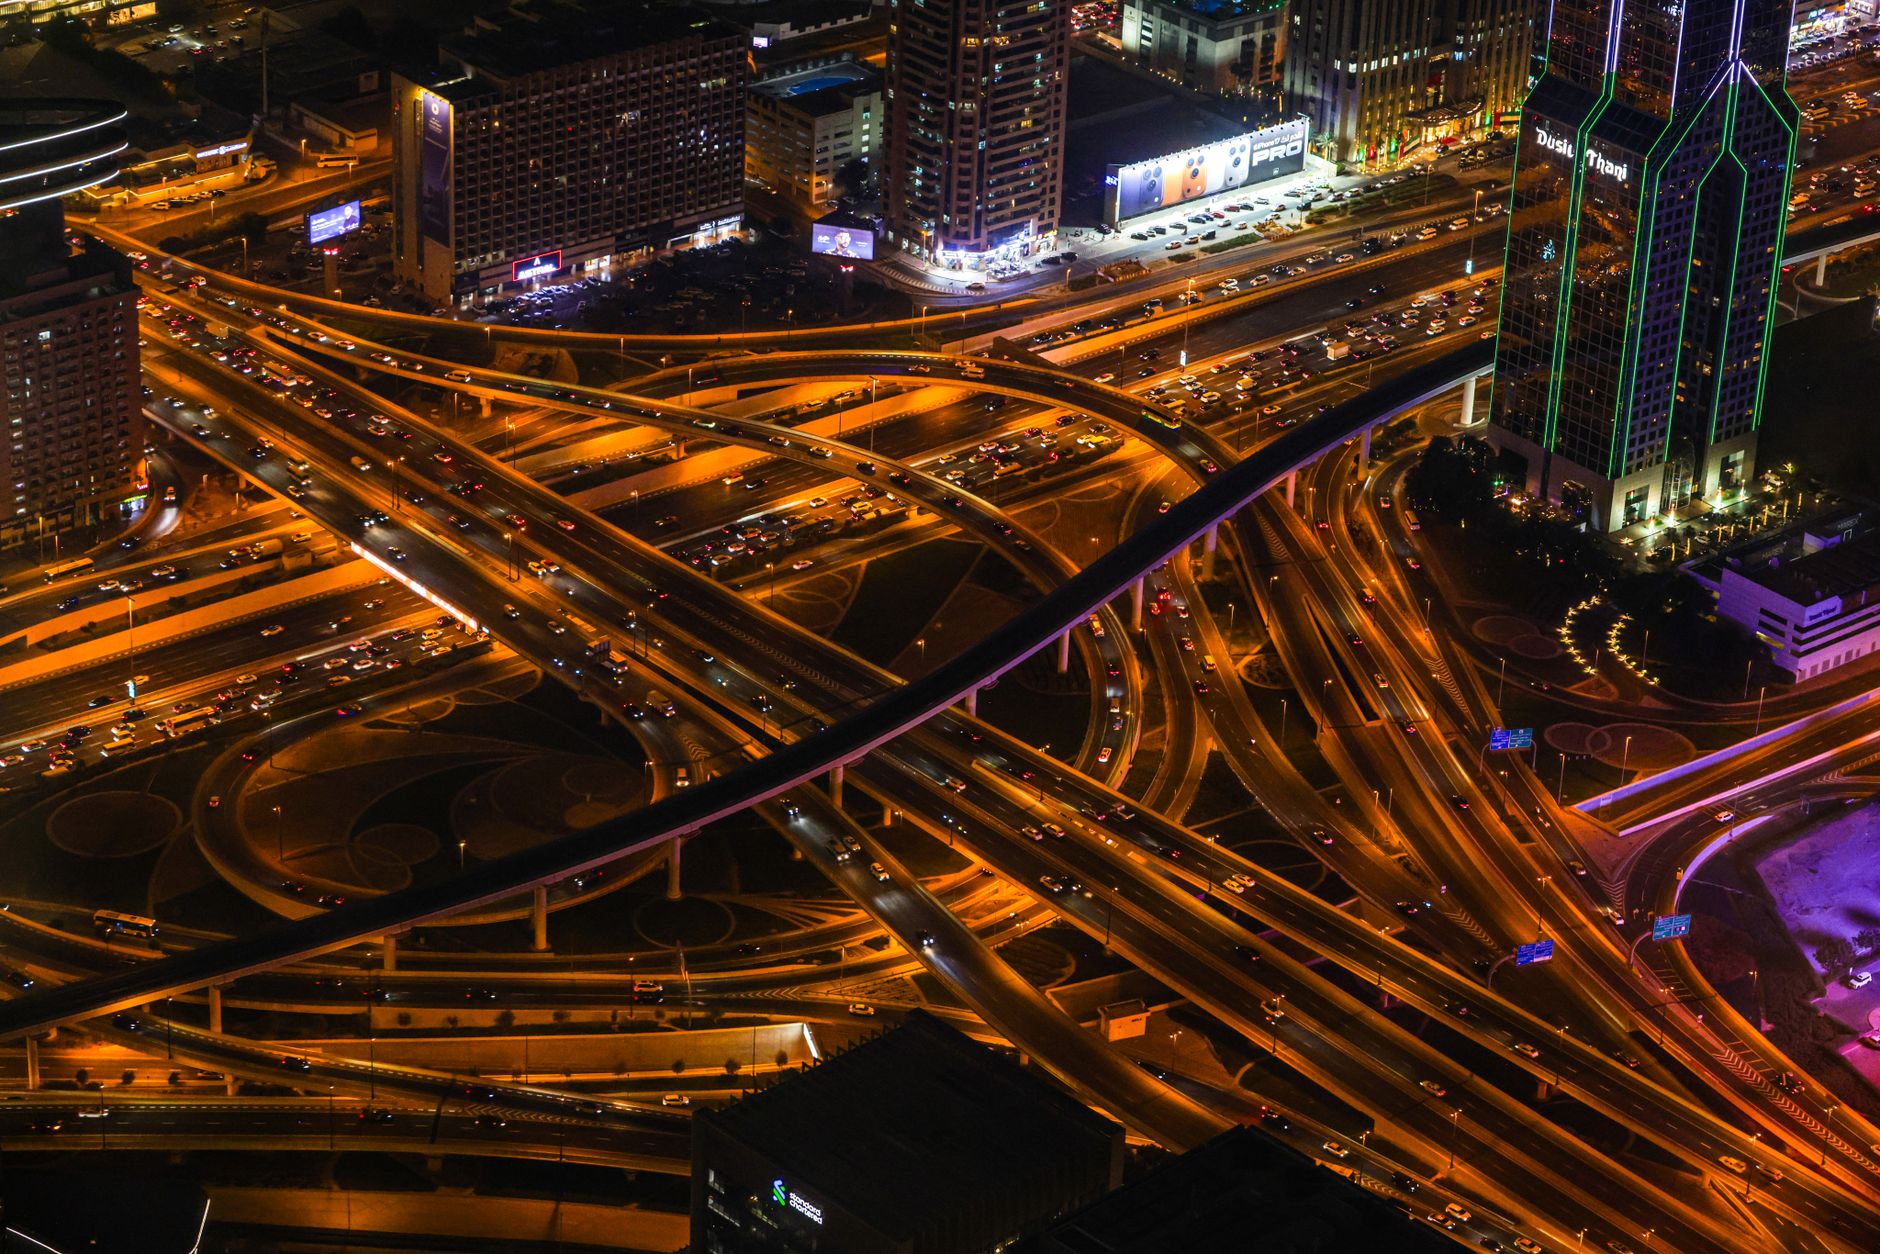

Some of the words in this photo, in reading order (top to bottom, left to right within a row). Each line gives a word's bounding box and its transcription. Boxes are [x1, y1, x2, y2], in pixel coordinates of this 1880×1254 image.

[1252, 140, 1303, 167] PRO
[1257, 141, 1275, 149] iPhone
[1535, 126, 1575, 158] Dusit
[1585, 147, 1628, 182] Thani
[517, 263, 557, 281] ASTRAL
[789, 1192, 821, 1217] standard
[789, 1199, 823, 1225] chartered
